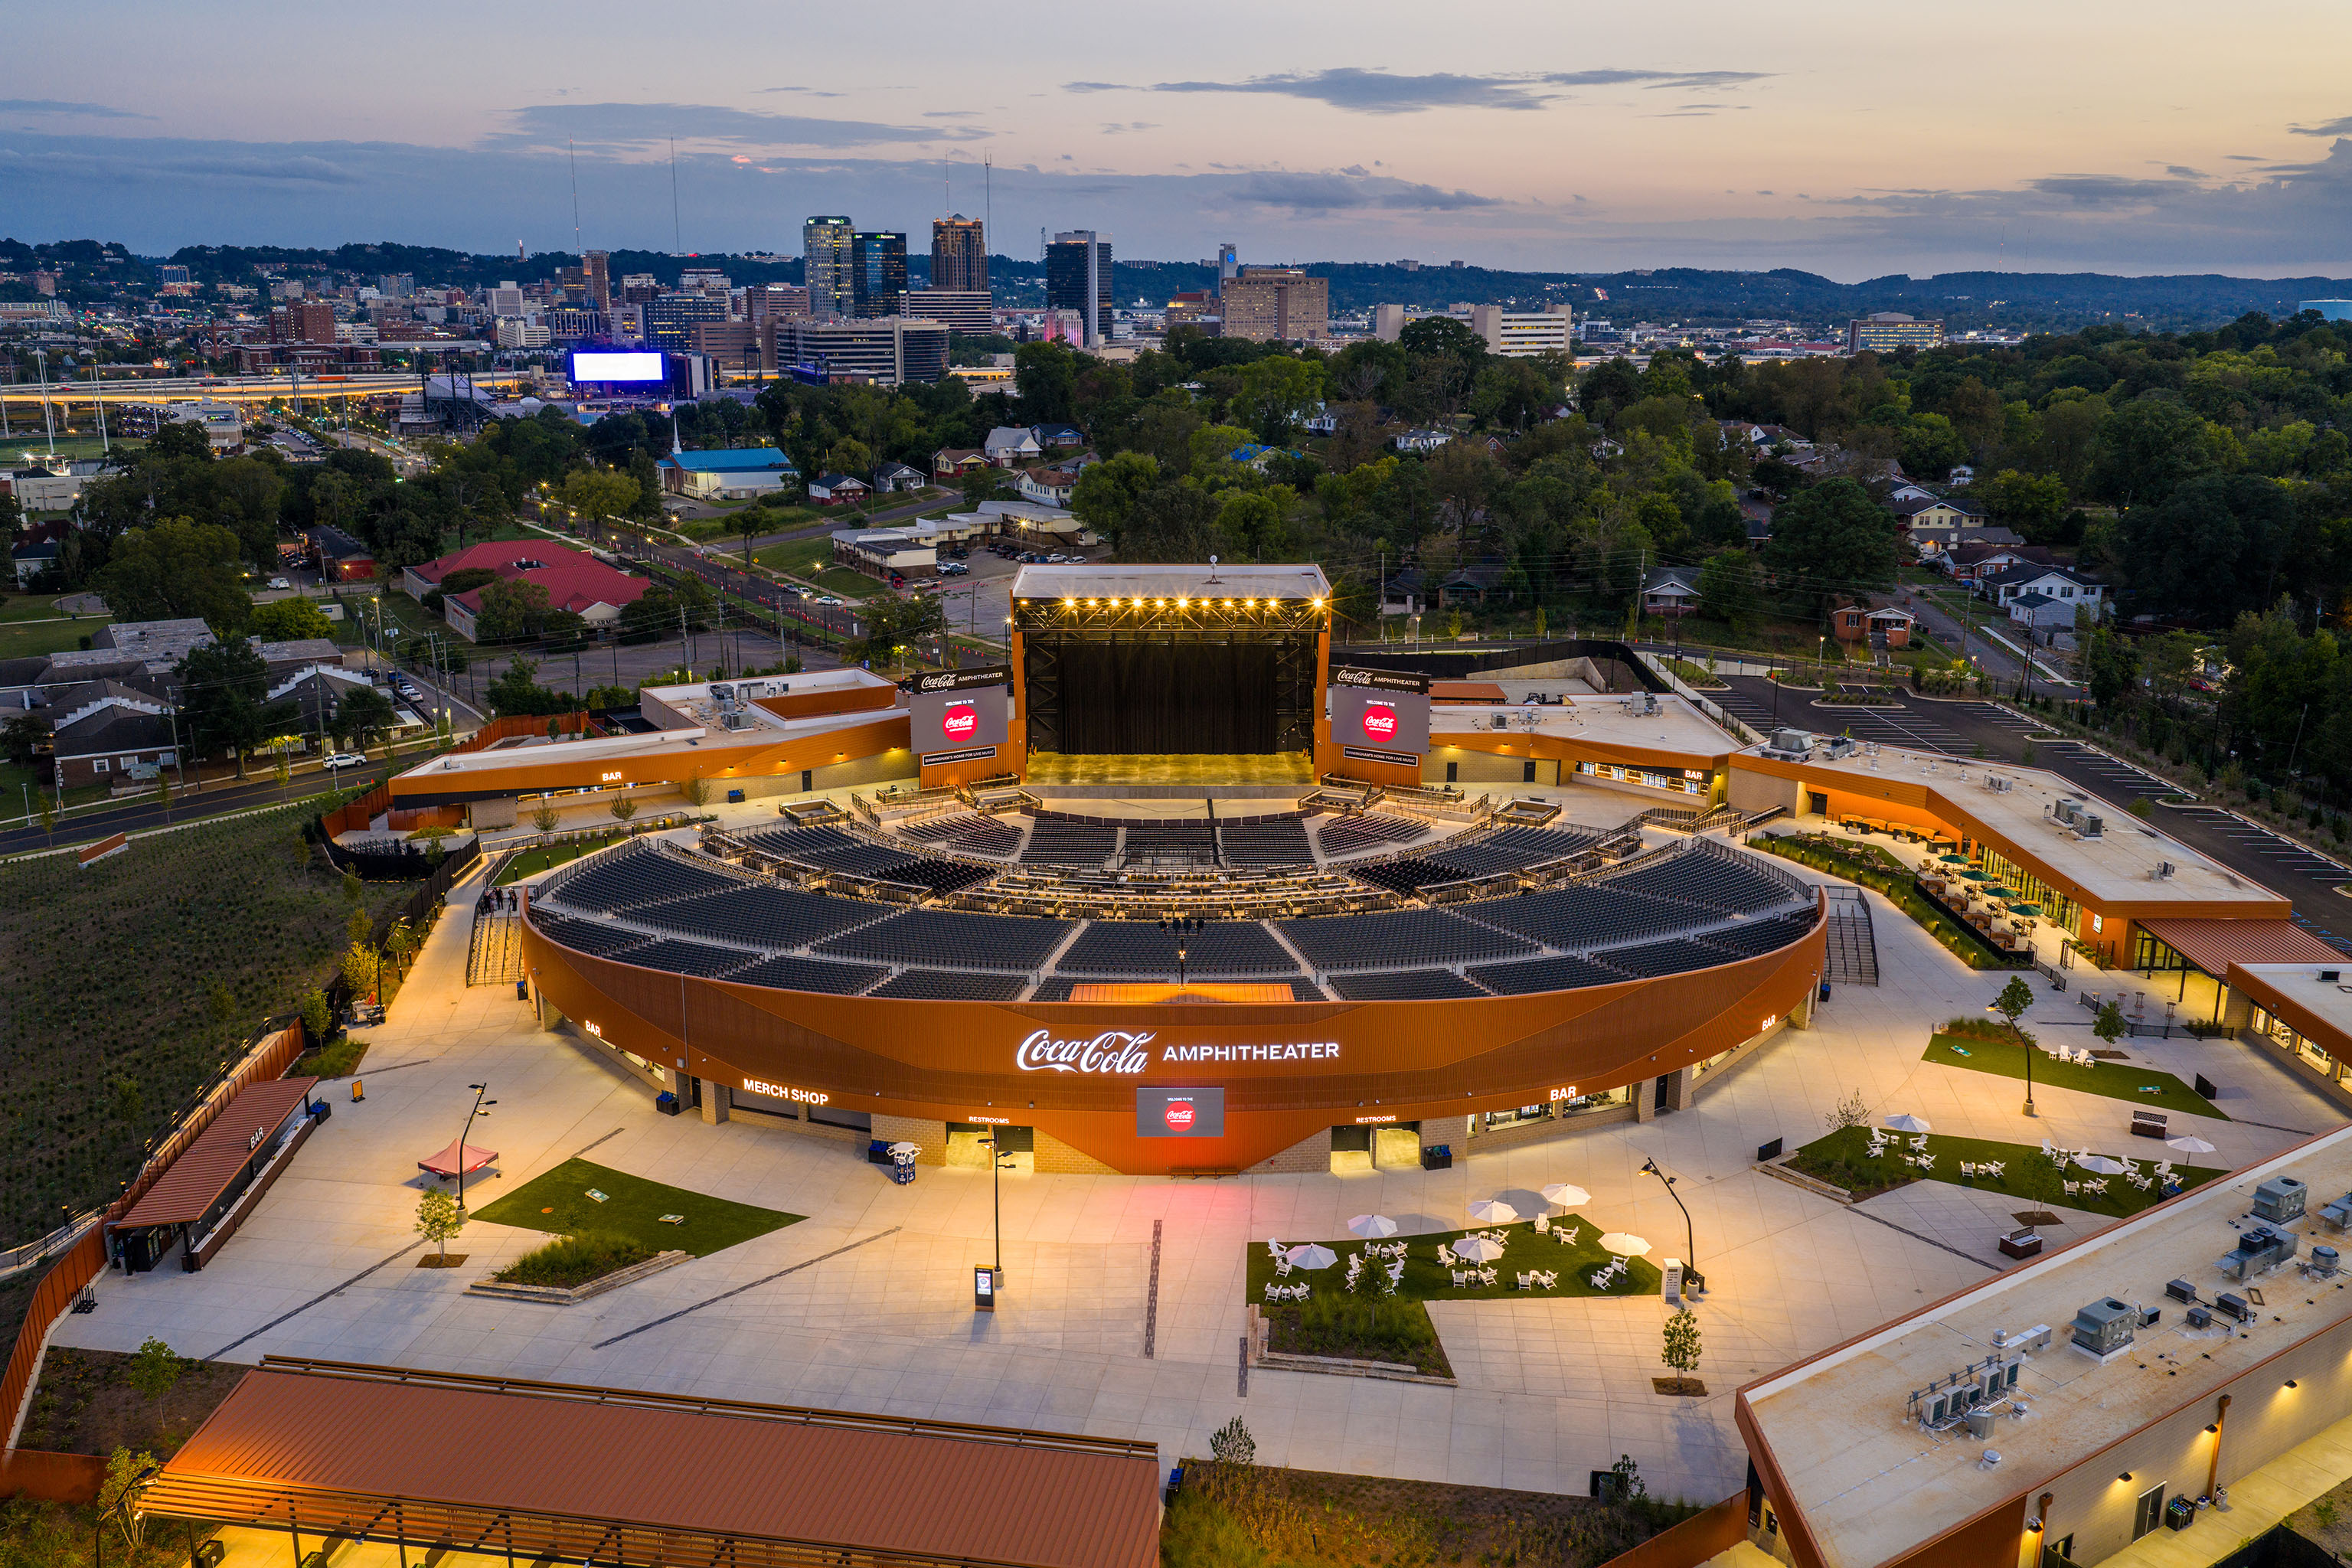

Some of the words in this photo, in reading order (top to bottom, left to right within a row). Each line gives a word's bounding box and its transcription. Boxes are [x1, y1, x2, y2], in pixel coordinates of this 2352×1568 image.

[921, 673, 957, 689] Coca-Cola
[958, 671, 1003, 682] AMPHITHEATER
[1337, 669, 1374, 685] Coca-Cola
[1374, 676, 1420, 687] AMPHITHEATER
[946, 715, 975, 728] Coca-Cola
[1365, 715, 1394, 728] Coca-Cola
[602, 771, 622, 782] BAR
[1685, 769, 1703, 779] BAR
[585, 1020, 601, 1037] BAR
[1762, 1014, 1775, 1031] BAR
[1016, 1030, 1158, 1074] Coca-Cola
[1162, 1042, 1340, 1062] AMPHITHEATER
[743, 1078, 789, 1099] MERCH
[791, 1088, 828, 1106] SHOP
[1550, 1086, 1576, 1101] BAR
[969, 1116, 1010, 1124] RESTROOMS
[1167, 1110, 1194, 1120] Coca-Cola
[1356, 1115, 1396, 1123] RESTROOMS
[250, 1126, 263, 1149] BAR
